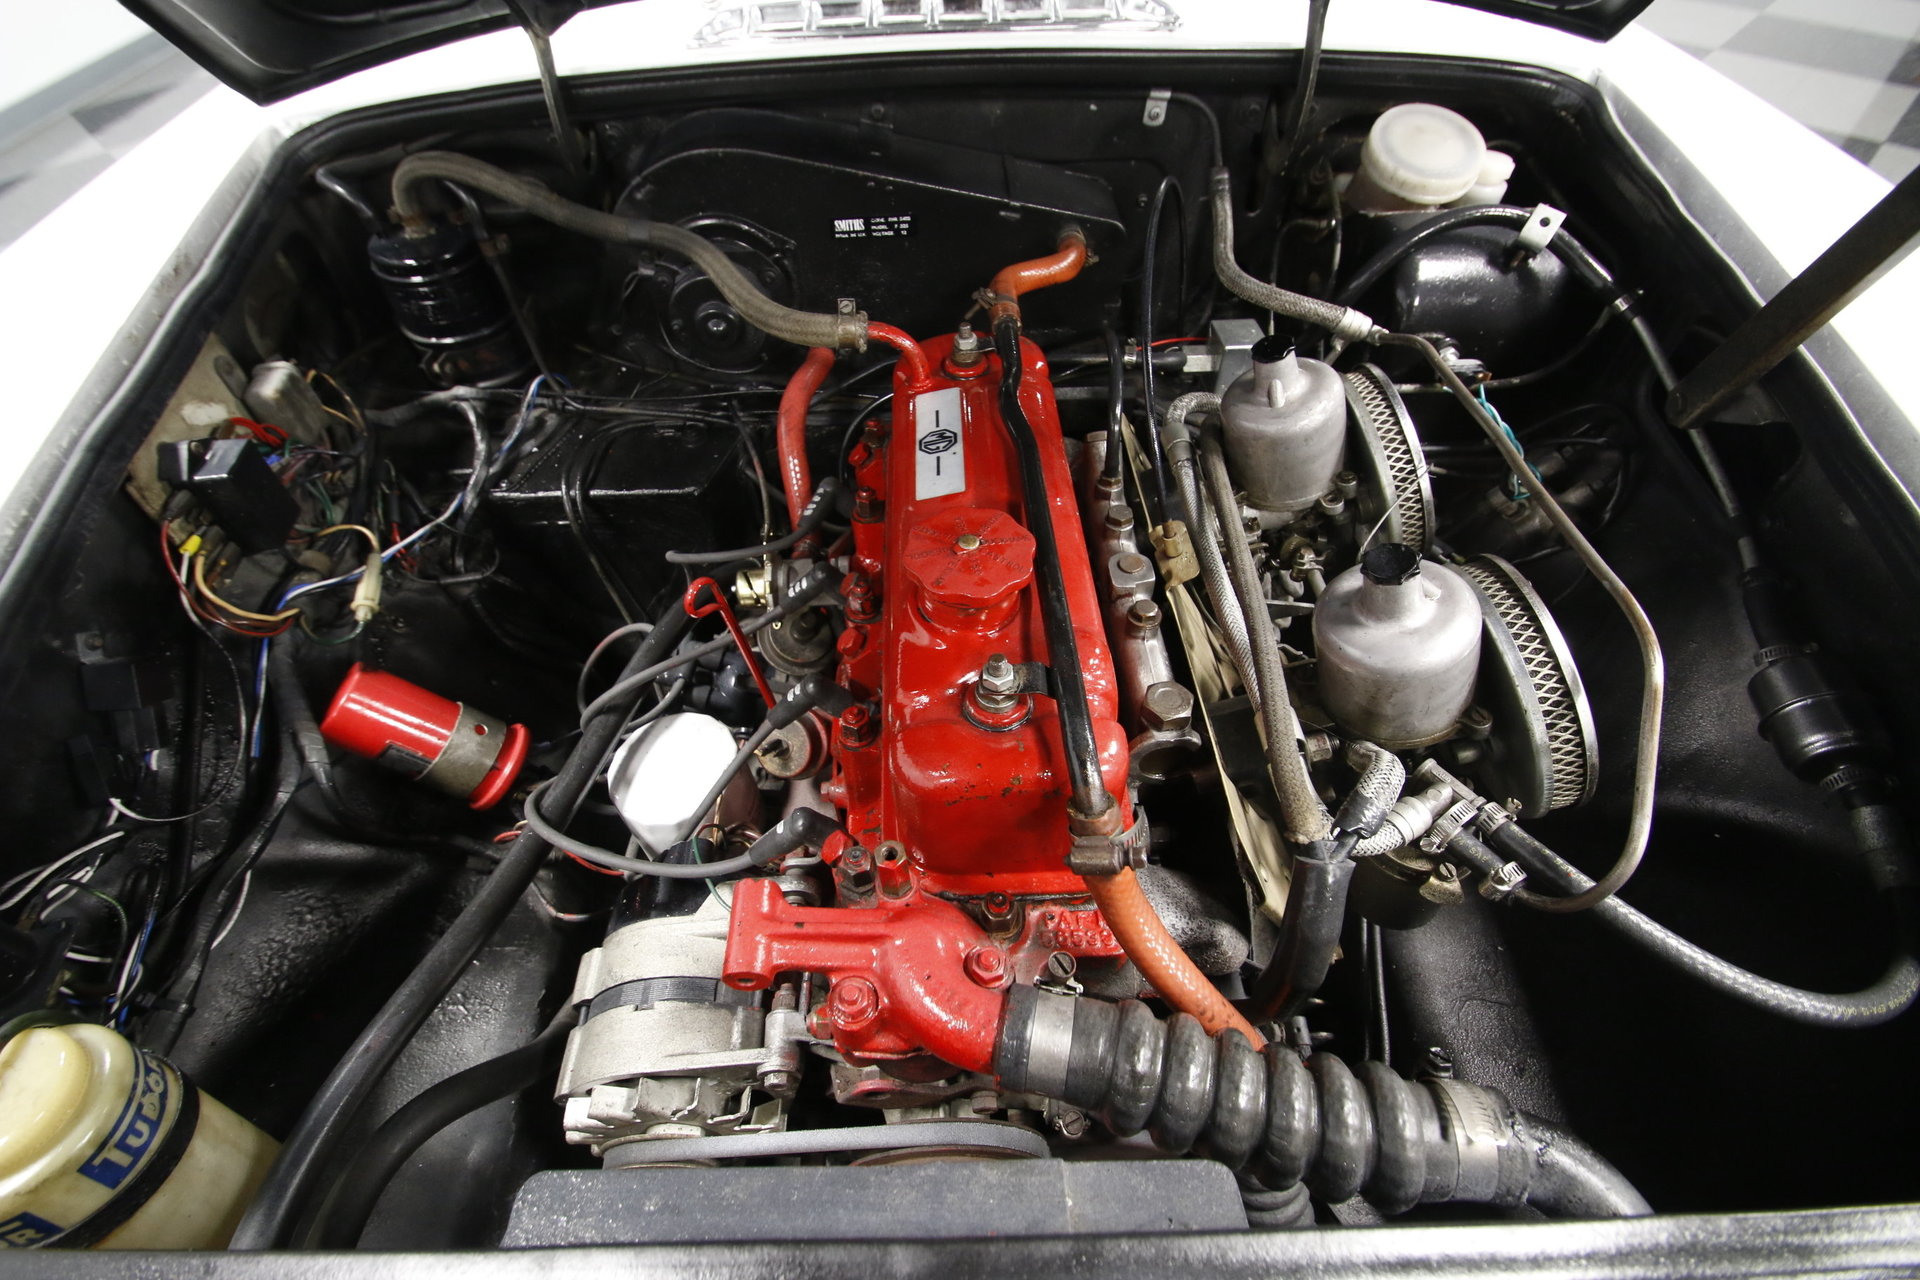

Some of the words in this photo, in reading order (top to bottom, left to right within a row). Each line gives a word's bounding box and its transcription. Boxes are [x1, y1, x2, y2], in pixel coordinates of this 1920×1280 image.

[834, 219, 865, 231] SMITHS
[921, 430, 956, 453] MG
[92, 1055, 164, 1168] TUDOR
